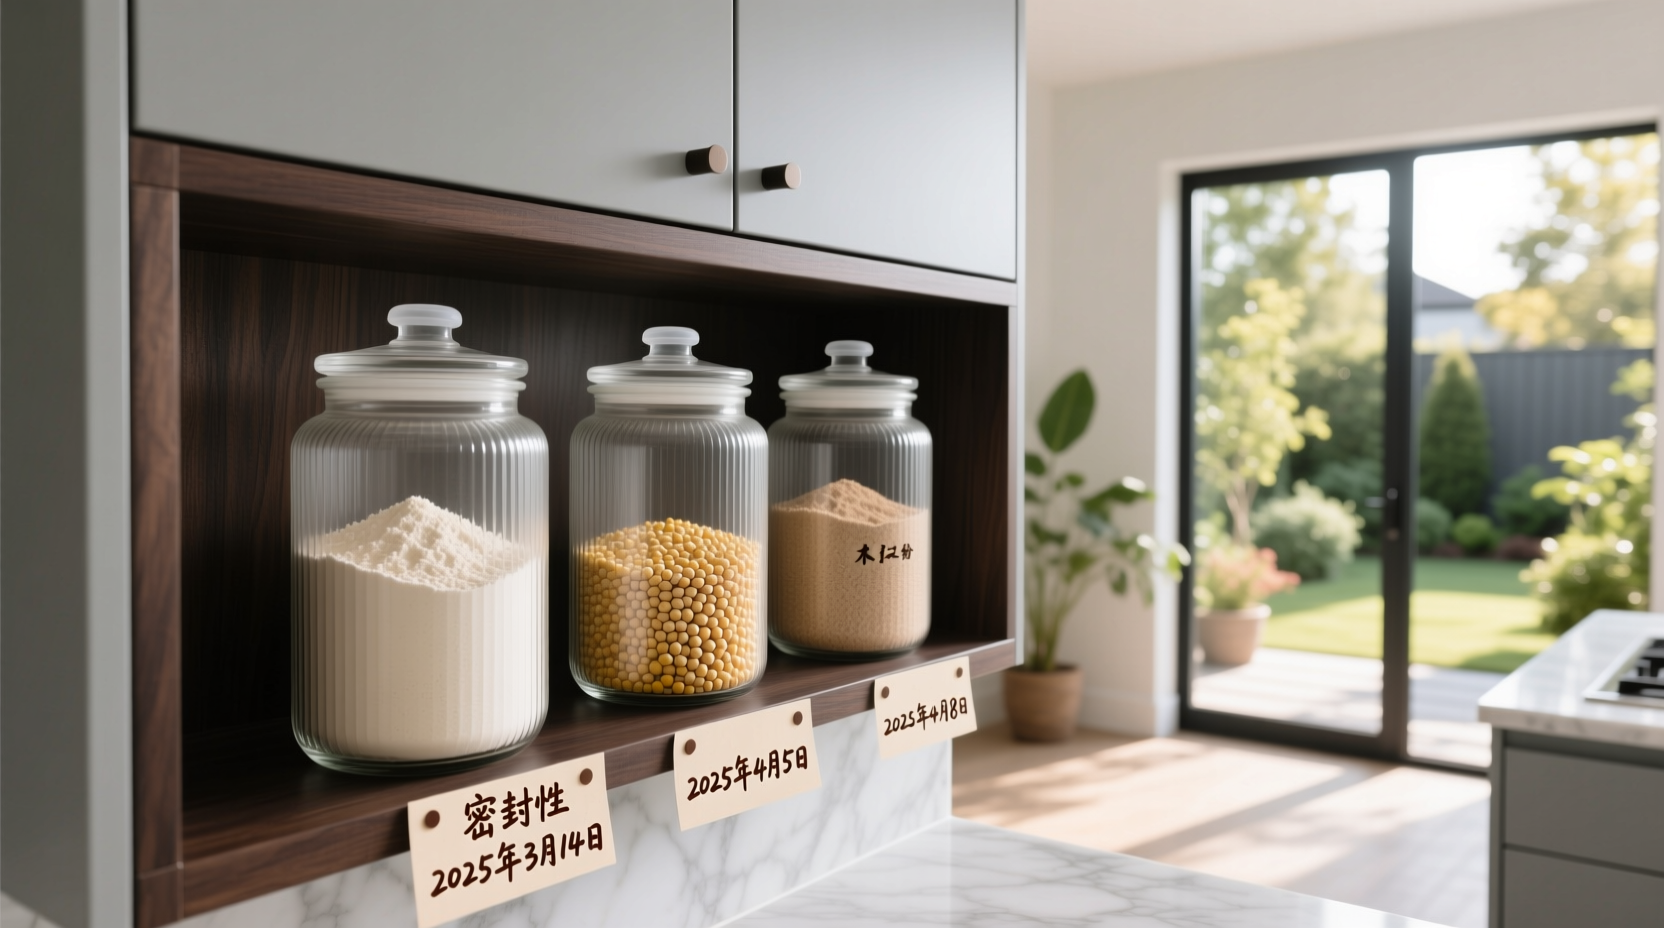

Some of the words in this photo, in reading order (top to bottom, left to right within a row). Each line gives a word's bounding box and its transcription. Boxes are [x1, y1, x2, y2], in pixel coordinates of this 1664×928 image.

[884, 697, 968, 736] 2025年4月8日
[687, 745, 808, 801] 2025年4月5日
[464, 782, 570, 841] 密封性
[431, 823, 603, 898] 2025年3月14日
